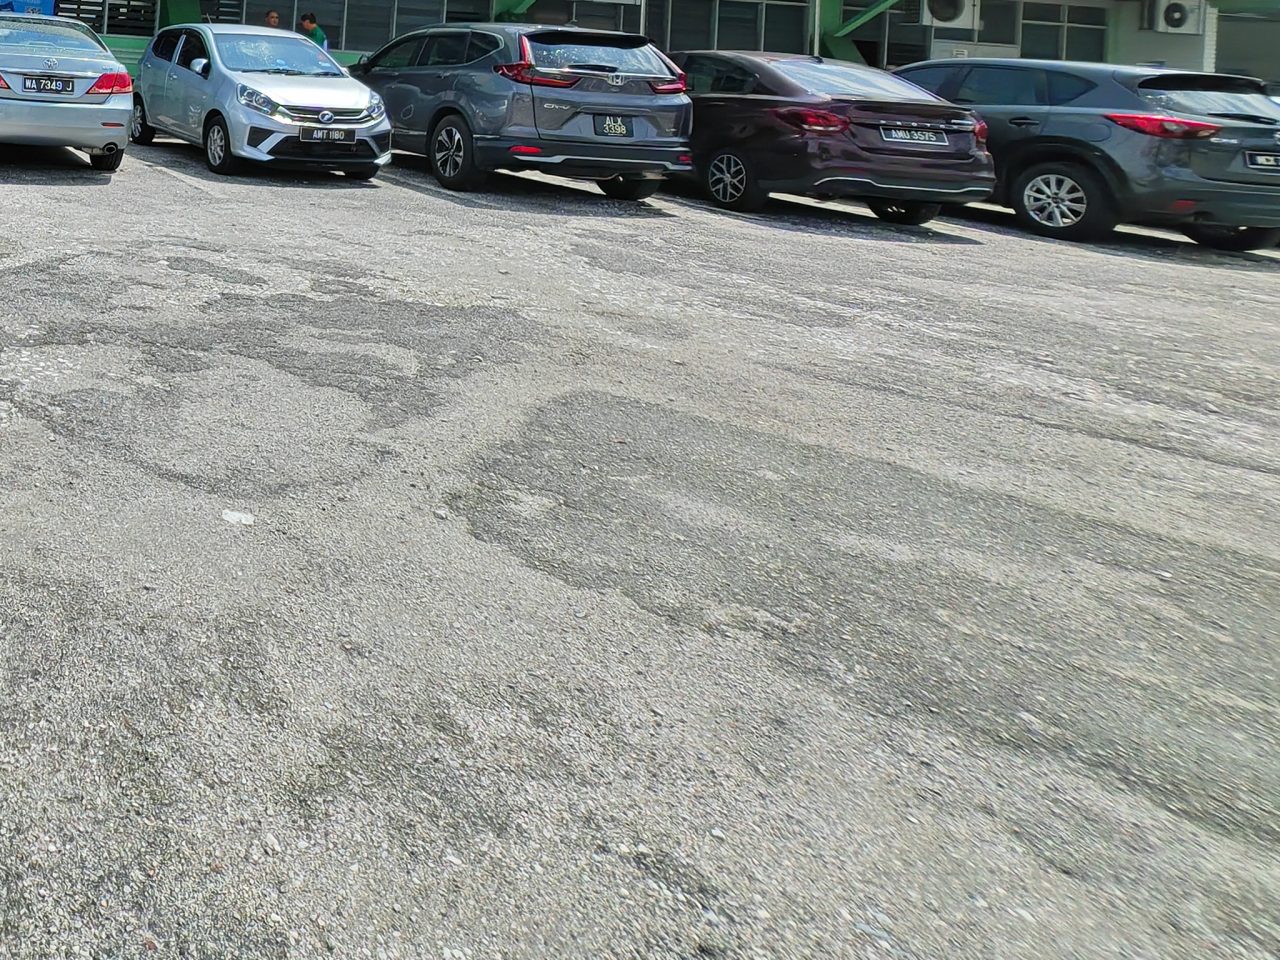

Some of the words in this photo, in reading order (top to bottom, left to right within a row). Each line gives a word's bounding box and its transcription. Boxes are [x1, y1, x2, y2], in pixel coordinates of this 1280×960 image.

[25, 79, 37, 89] WA
[40, 80, 63, 90] 7349
[66, 82, 72, 91] J
[605, 116, 623, 126] ALX
[603, 124, 627, 134] 3398
[911, 130, 937, 141] 3575
